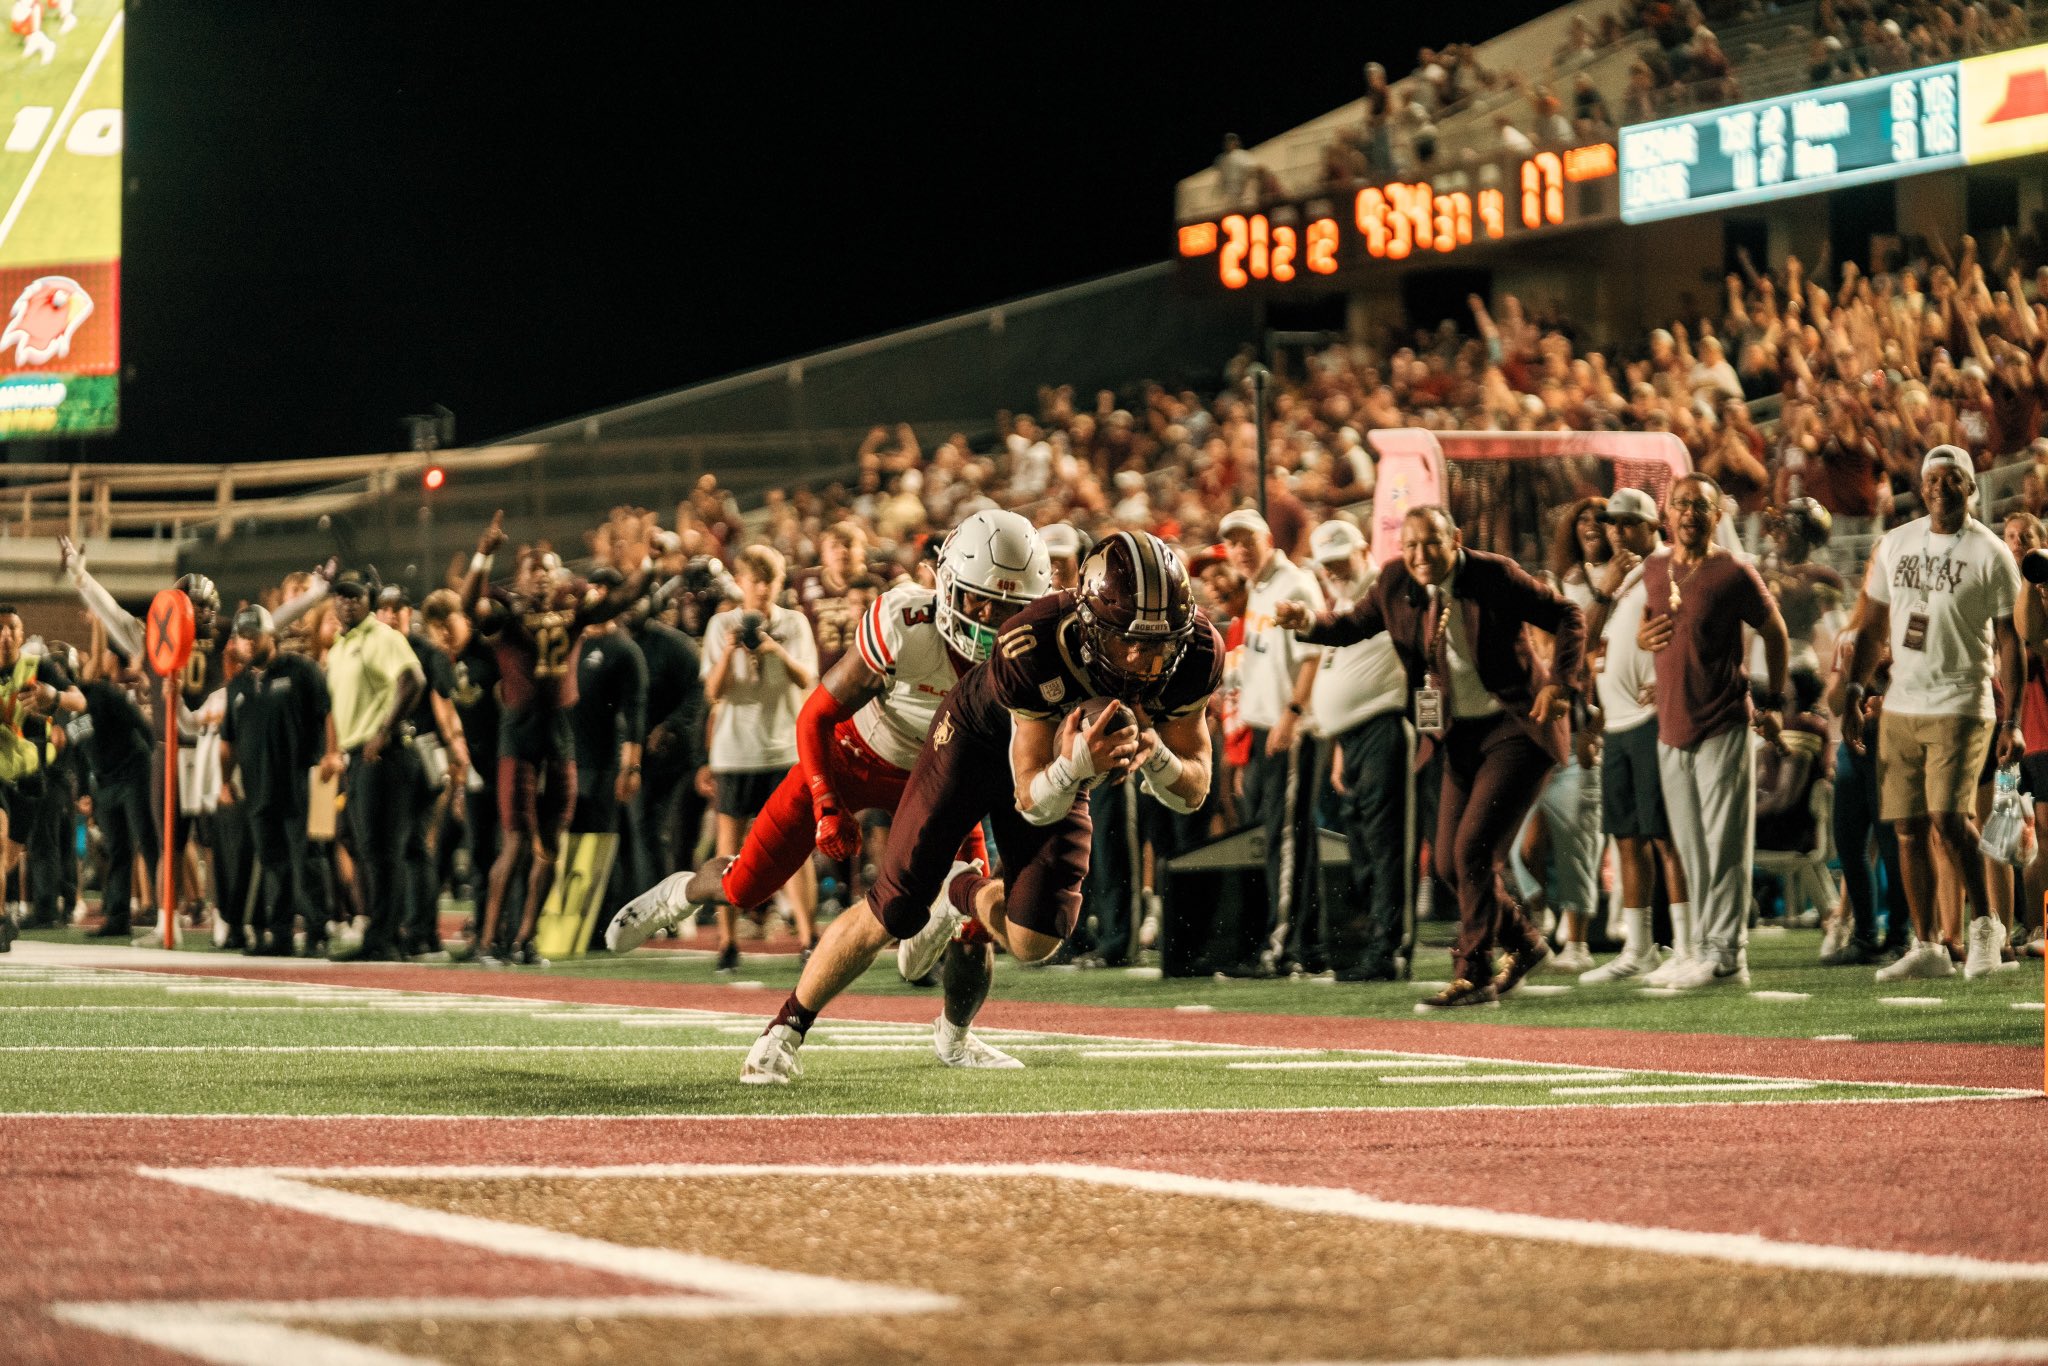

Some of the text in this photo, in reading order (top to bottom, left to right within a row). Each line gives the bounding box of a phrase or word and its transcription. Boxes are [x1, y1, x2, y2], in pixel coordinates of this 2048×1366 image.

[1893, 569, 1962, 594] ENGY
[998, 625, 1037, 658] 10
[1134, 623, 1169, 631] BOBCATS
[534, 628, 570, 677] 12
